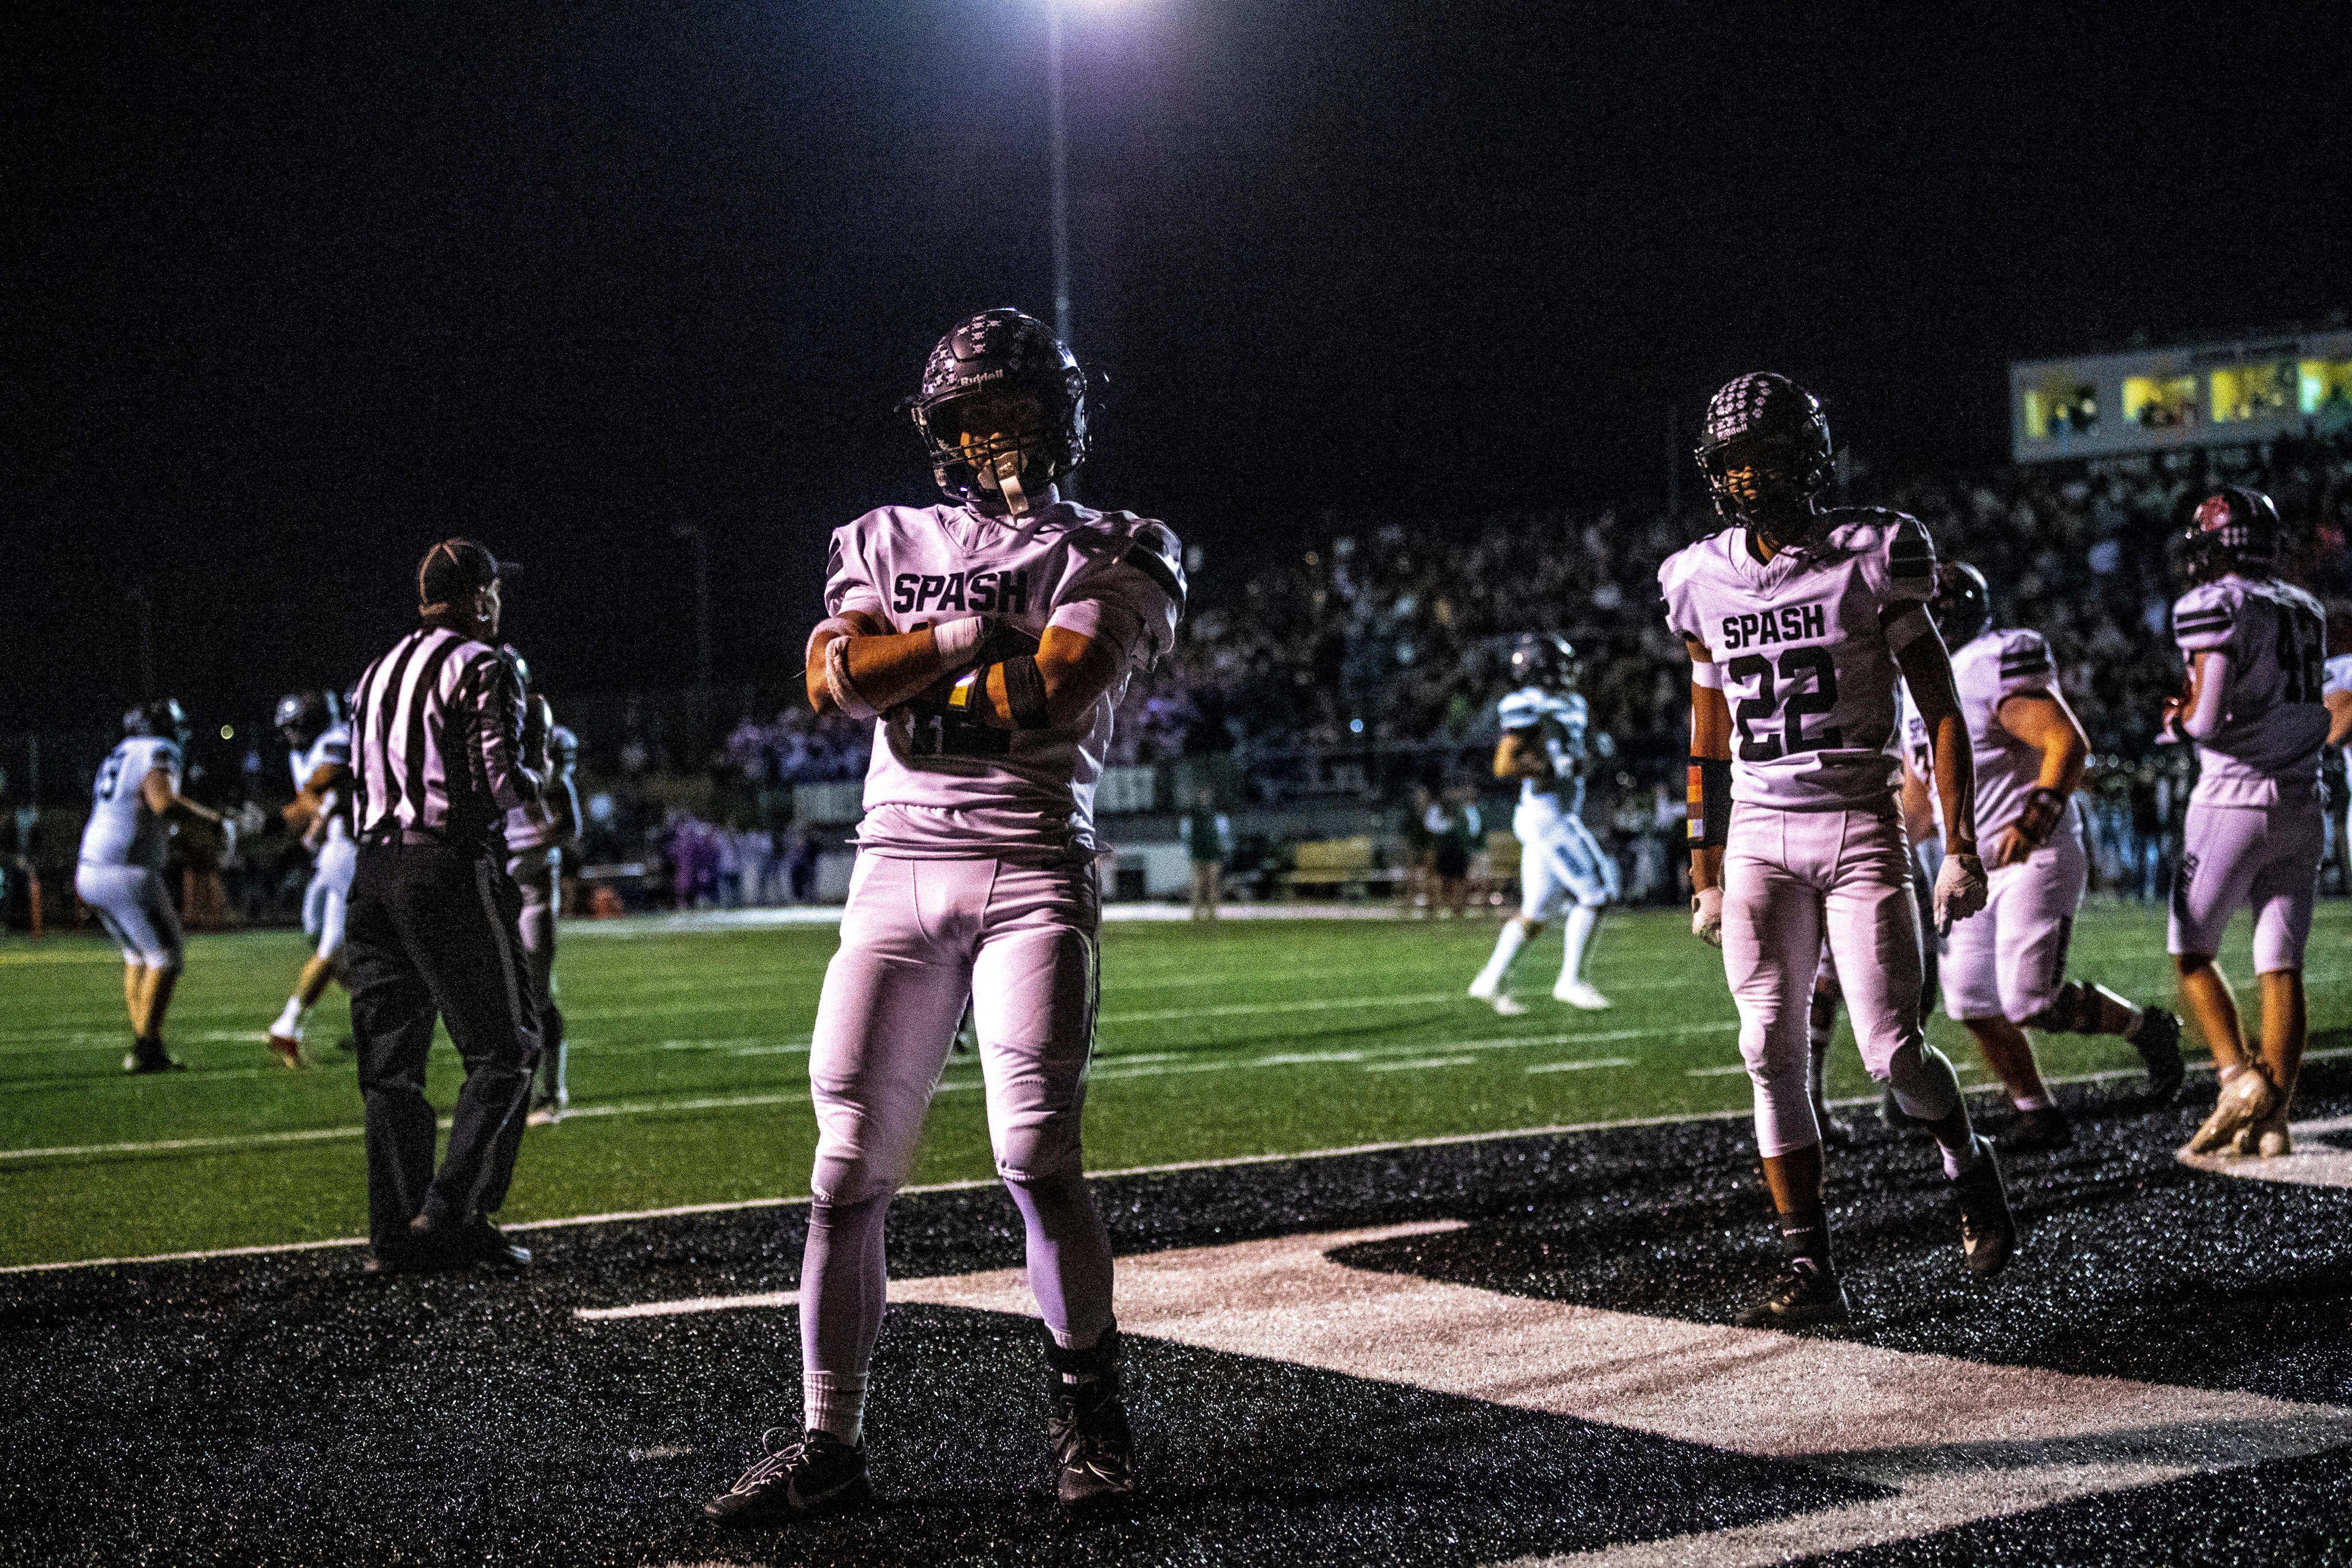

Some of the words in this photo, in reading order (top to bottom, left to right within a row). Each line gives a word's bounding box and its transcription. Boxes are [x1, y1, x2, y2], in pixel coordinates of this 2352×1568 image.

[960, 369, 1004, 386] Riddell
[894, 571, 1029, 614] SPASH
[1722, 604, 1825, 649] SPASH
[1728, 646, 1843, 761] 22
